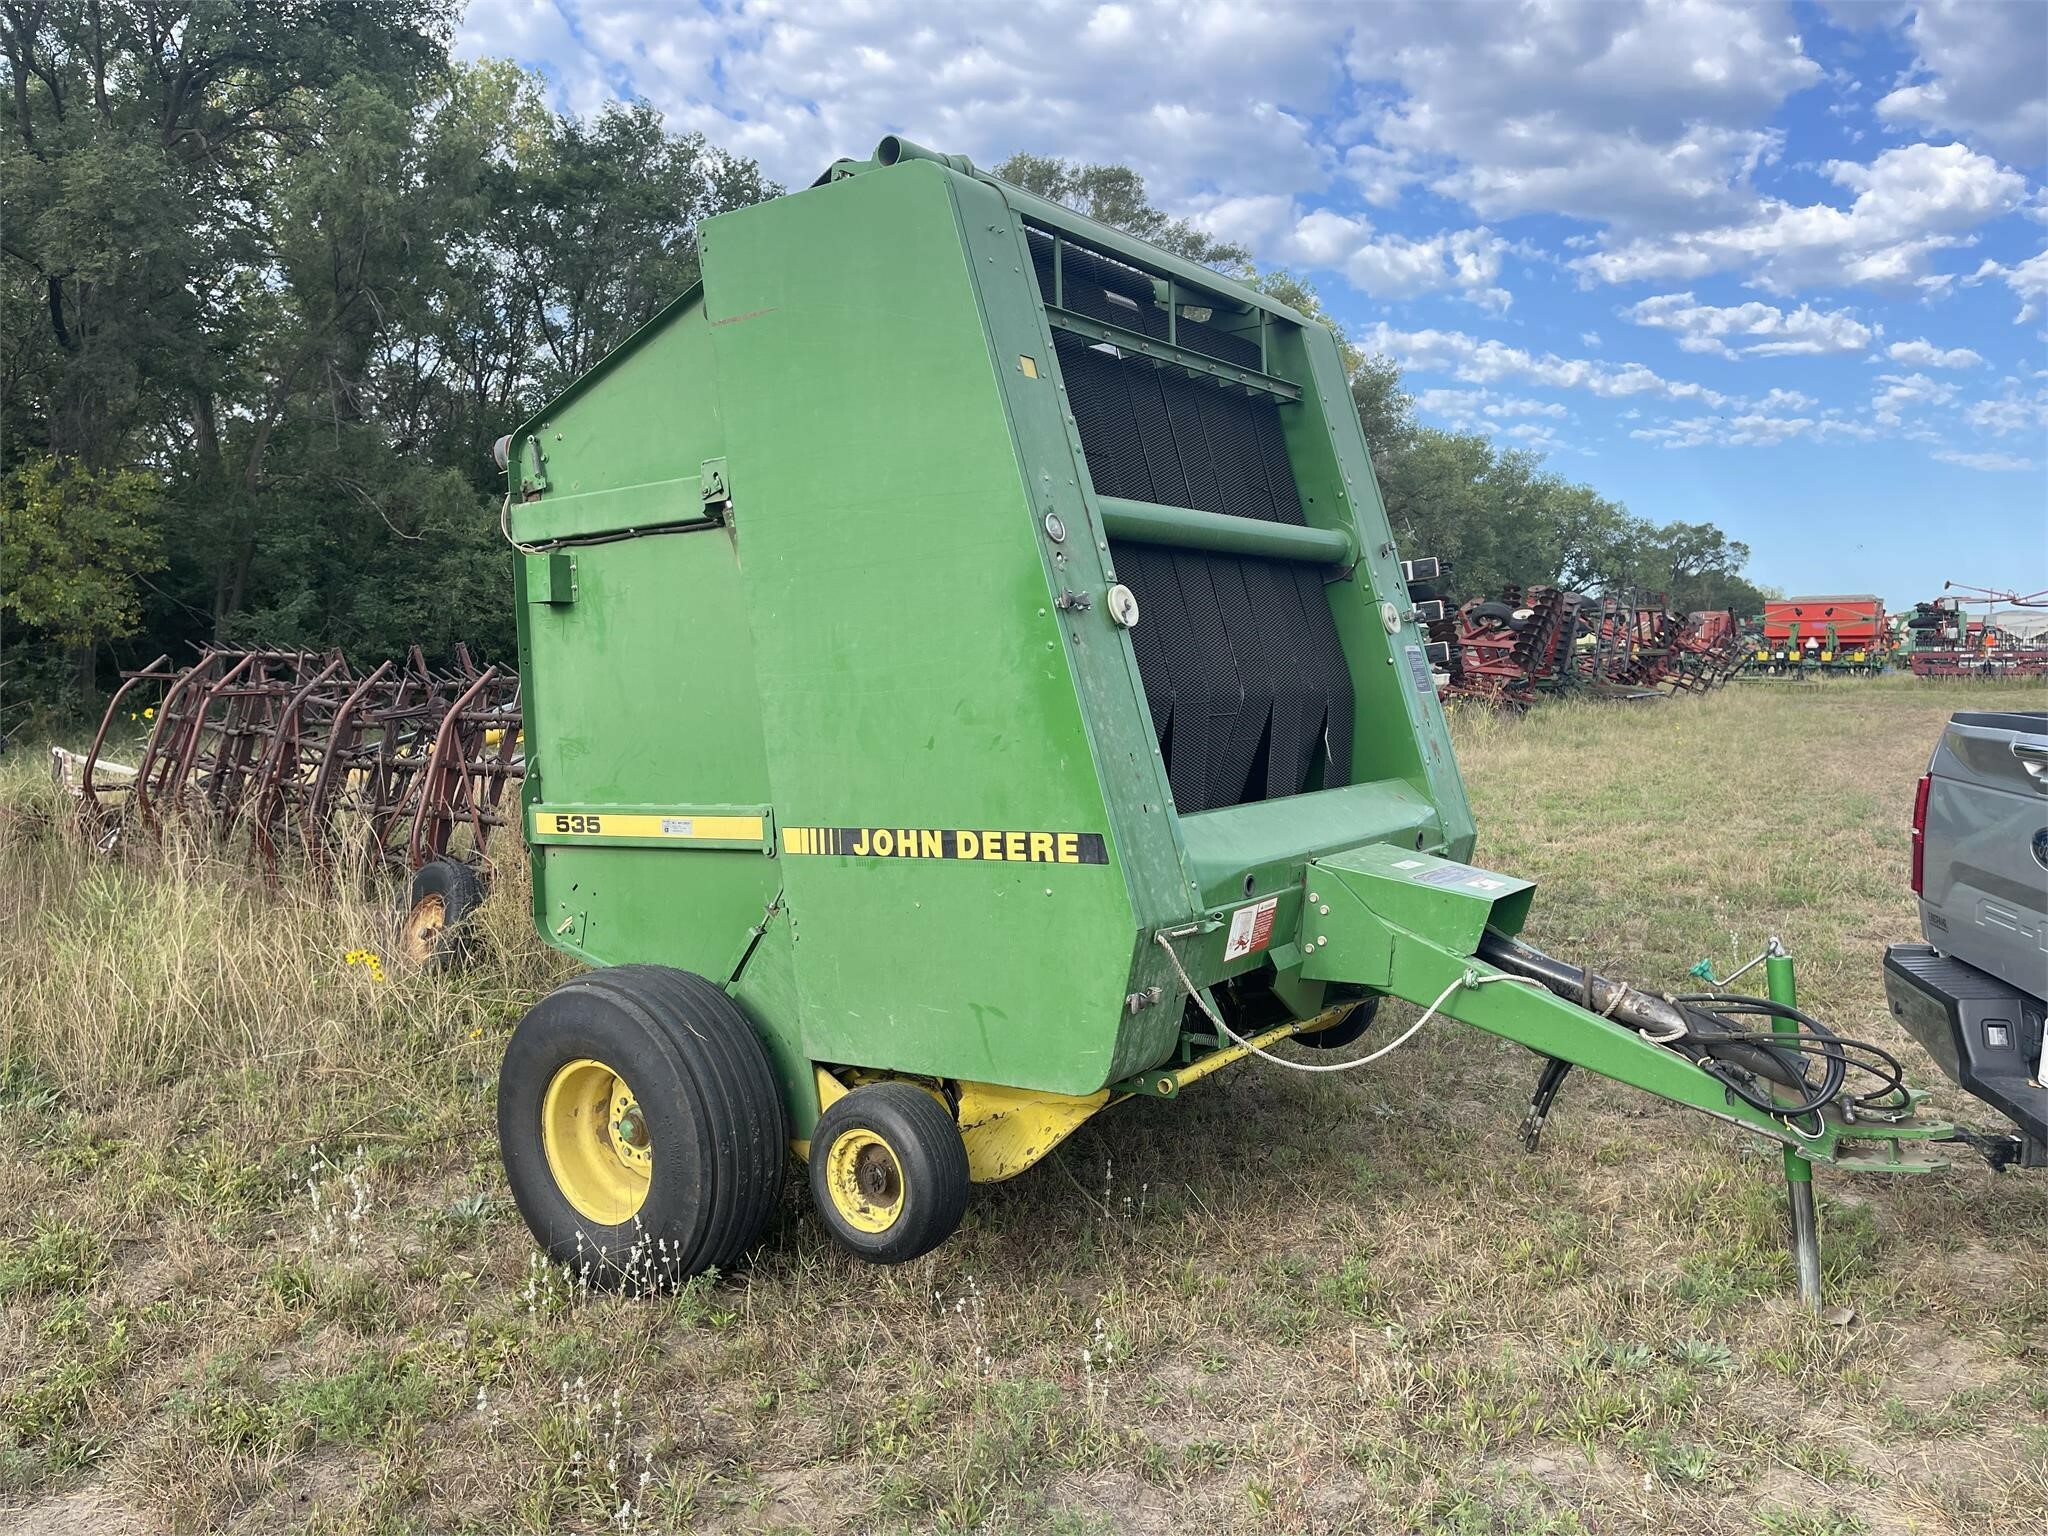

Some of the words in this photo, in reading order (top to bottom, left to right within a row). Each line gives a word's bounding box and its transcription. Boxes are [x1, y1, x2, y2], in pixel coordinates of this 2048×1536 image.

[556, 816, 600, 833] 535
[853, 829, 943, 858] JOHN
[956, 831, 1079, 863] DEERE
